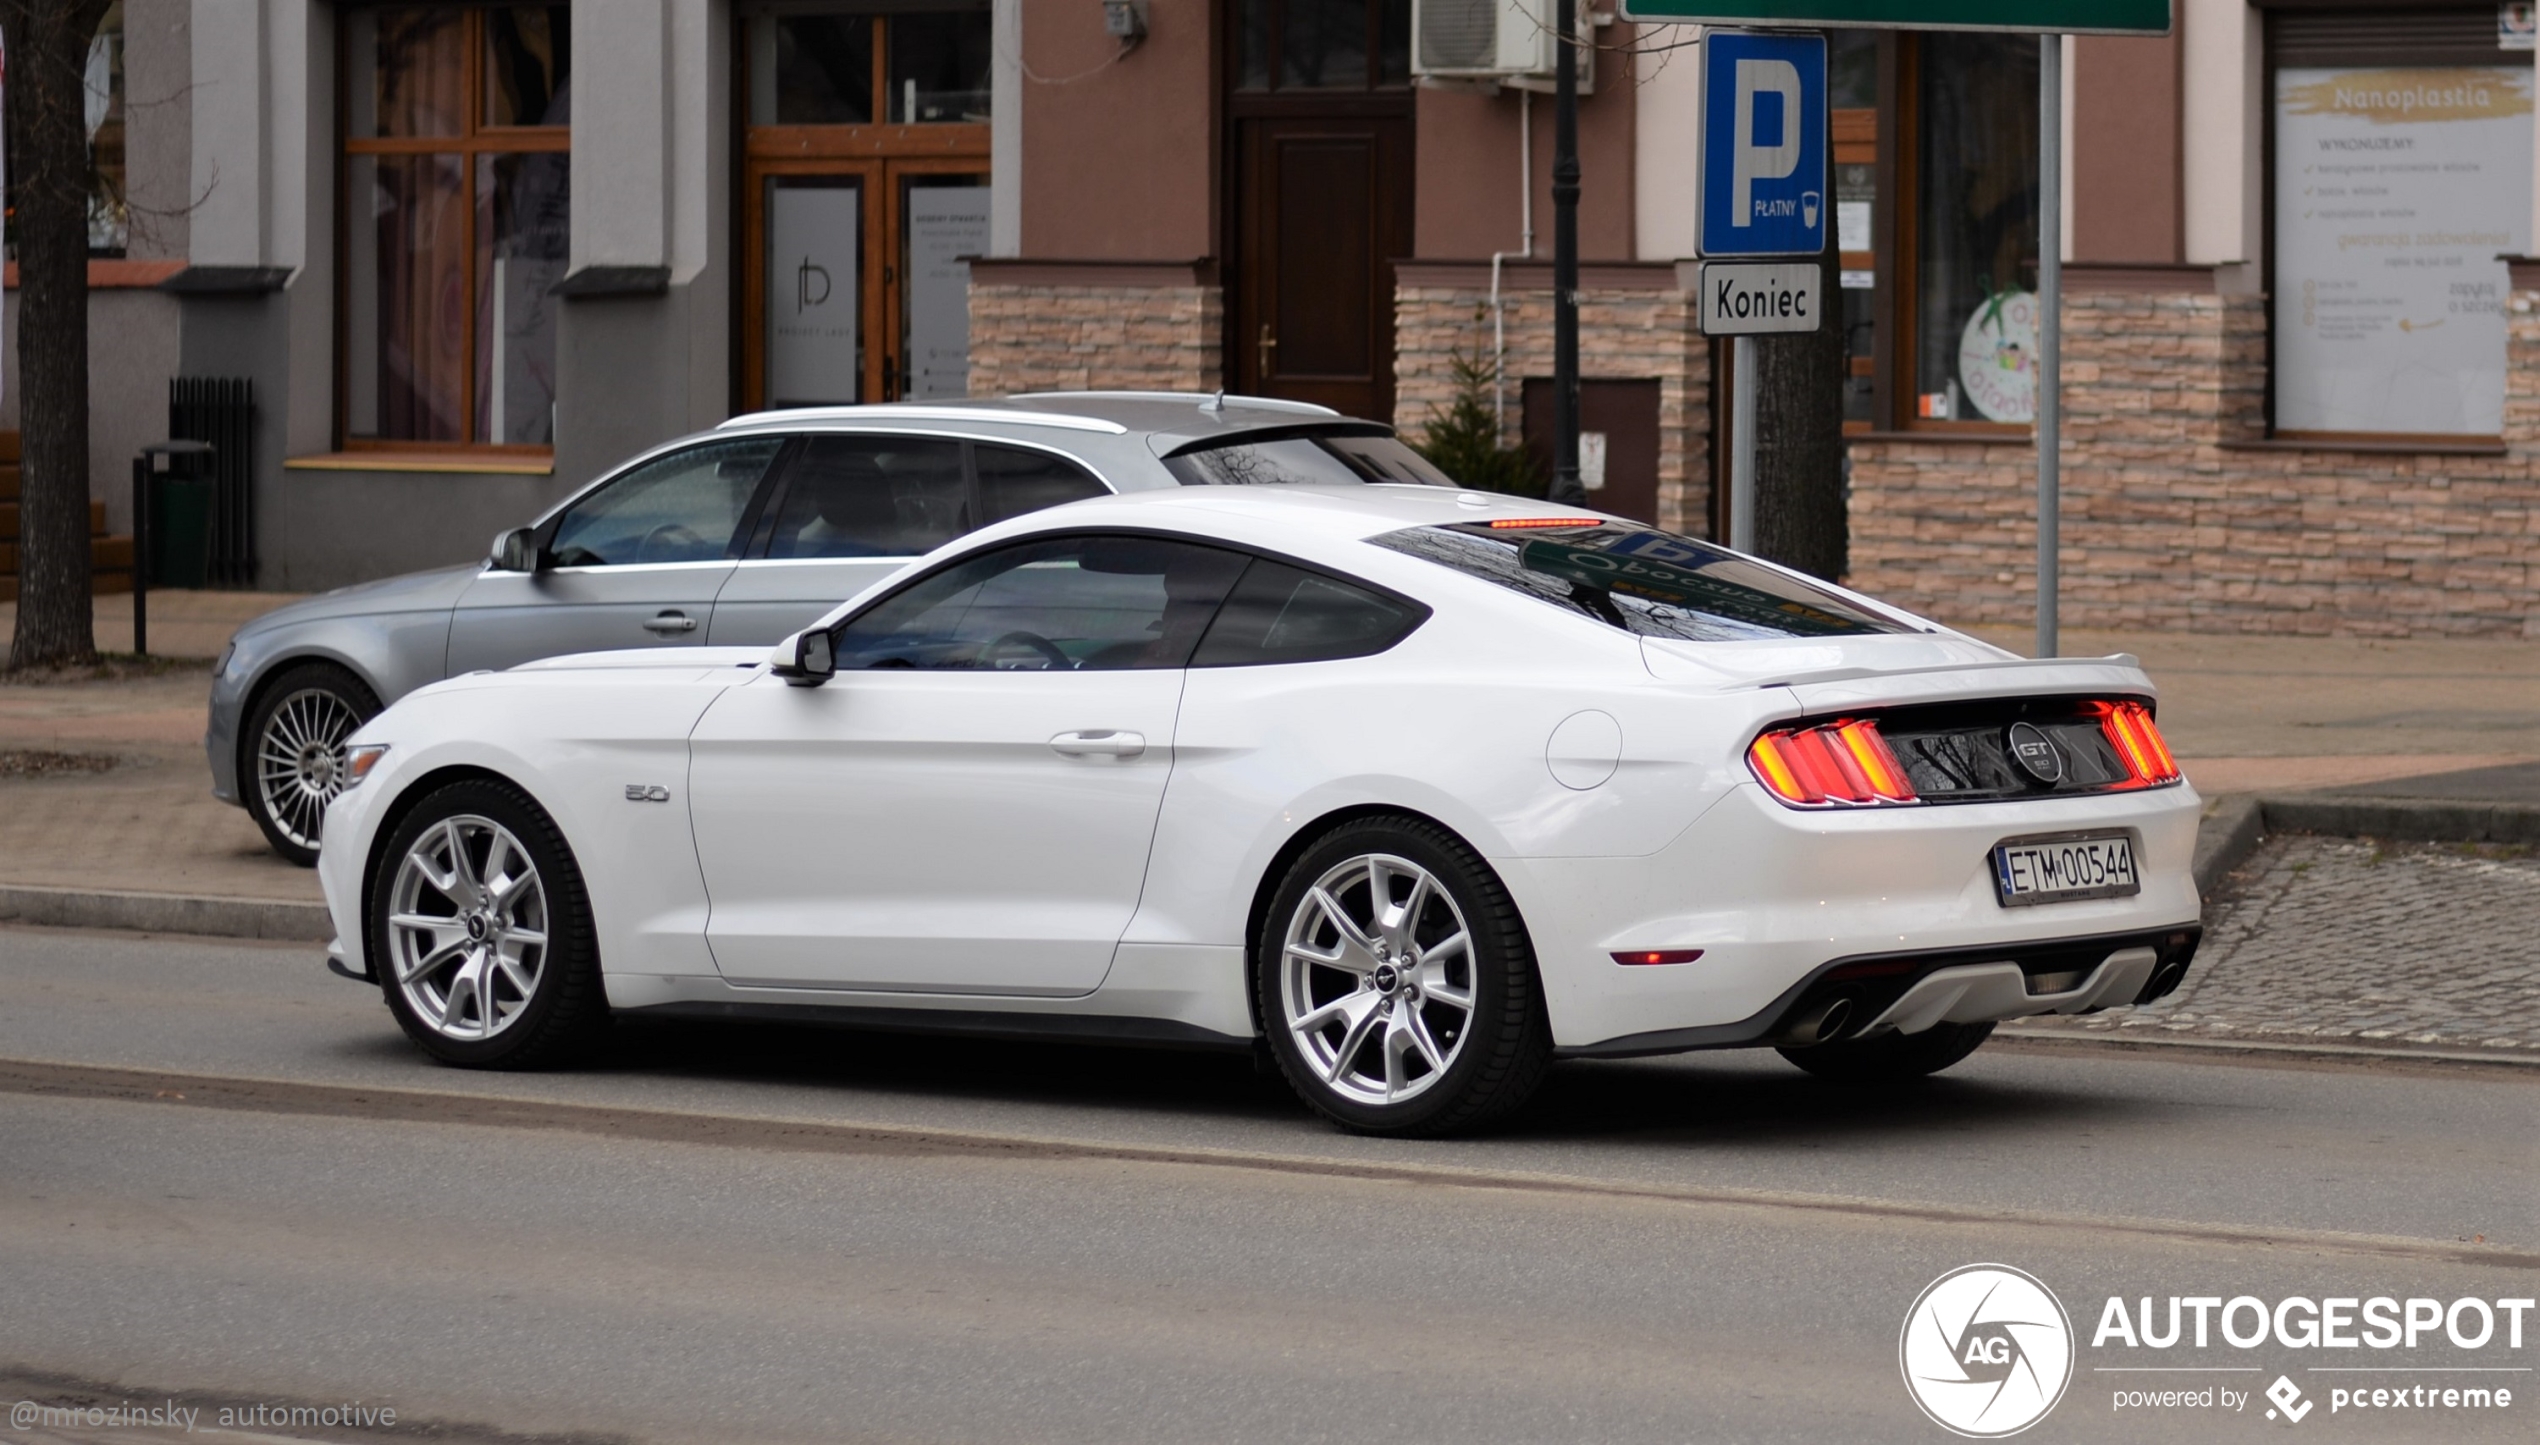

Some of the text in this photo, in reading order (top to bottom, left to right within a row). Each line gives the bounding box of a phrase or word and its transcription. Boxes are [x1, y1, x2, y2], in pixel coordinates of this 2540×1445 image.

[2334, 84, 2490, 112] Nanoplastia
[1732, 59, 1801, 228] P
[1755, 199, 1796, 217] PŁATNY
[1717, 279, 1807, 318] Koniec
[2449, 282, 2497, 300] zapytaj
[2019, 741, 2048, 757] GT
[2009, 843, 2131, 892] ETM 00544
